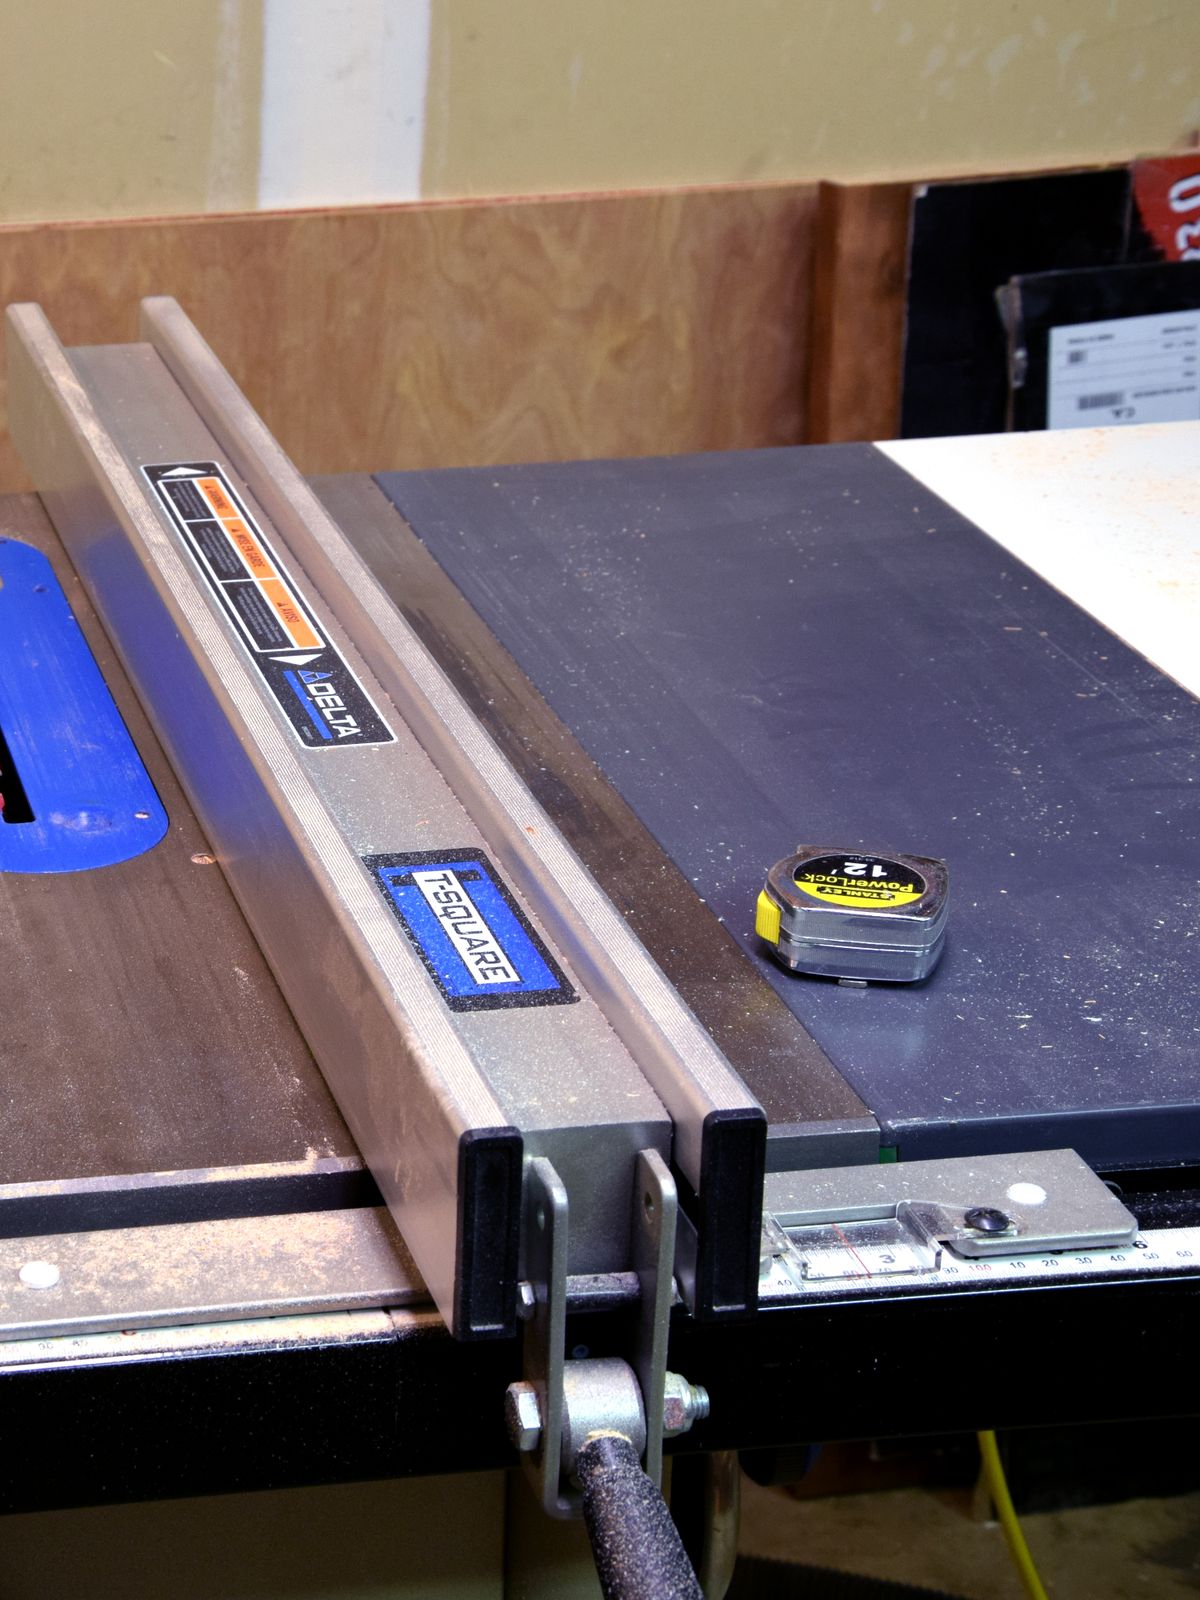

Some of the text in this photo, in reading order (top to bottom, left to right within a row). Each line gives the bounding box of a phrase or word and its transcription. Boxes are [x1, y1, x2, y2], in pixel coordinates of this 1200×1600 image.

[306, 682, 361, 738] DELTA
[821, 887, 891, 900] STANLEY
[424, 873, 511, 981] T-SQUARE
[879, 1254, 896, 1264] 3
